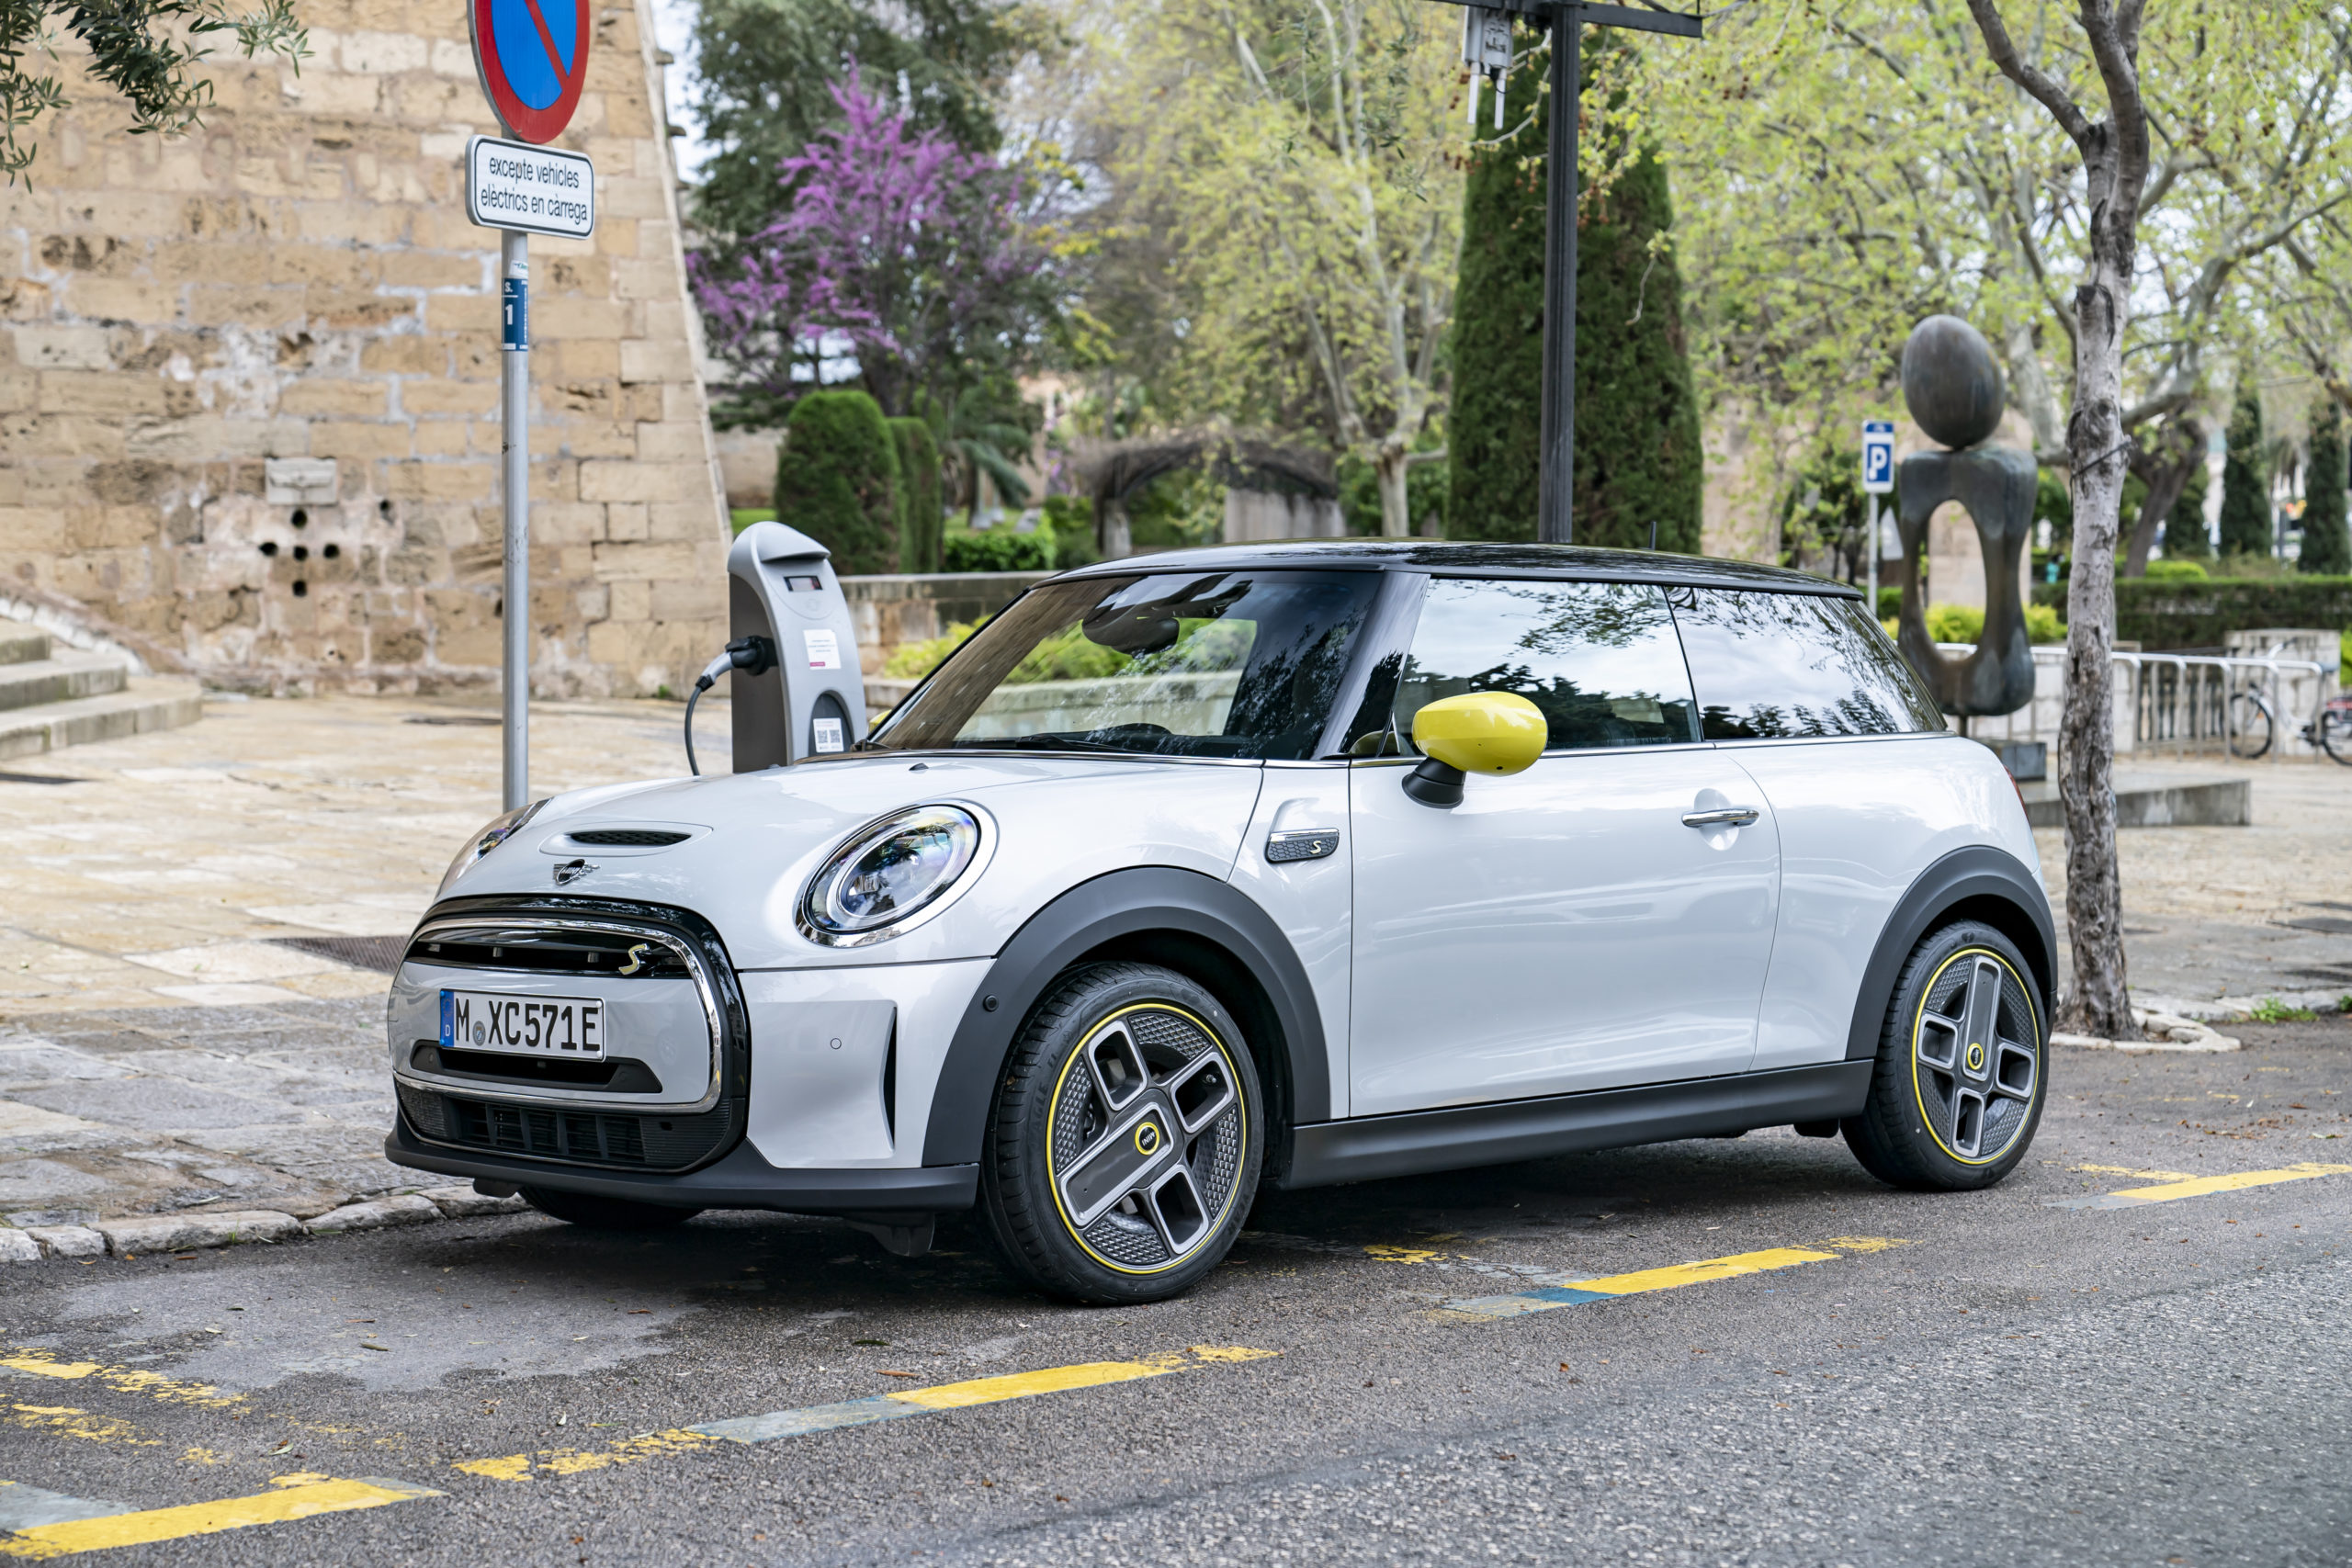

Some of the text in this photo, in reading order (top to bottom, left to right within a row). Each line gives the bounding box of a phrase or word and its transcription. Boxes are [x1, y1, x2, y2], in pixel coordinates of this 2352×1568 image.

[490, 157, 580, 188] excepte vehicles
[481, 184, 588, 225] elèctrics en càrrega
[505, 304, 513, 325] 1
[1868, 446, 1887, 480] P
[1309, 840, 1321, 854] S
[618, 942, 648, 976] S
[445, 1024, 451, 1037] D
[456, 998, 469, 1042] M
